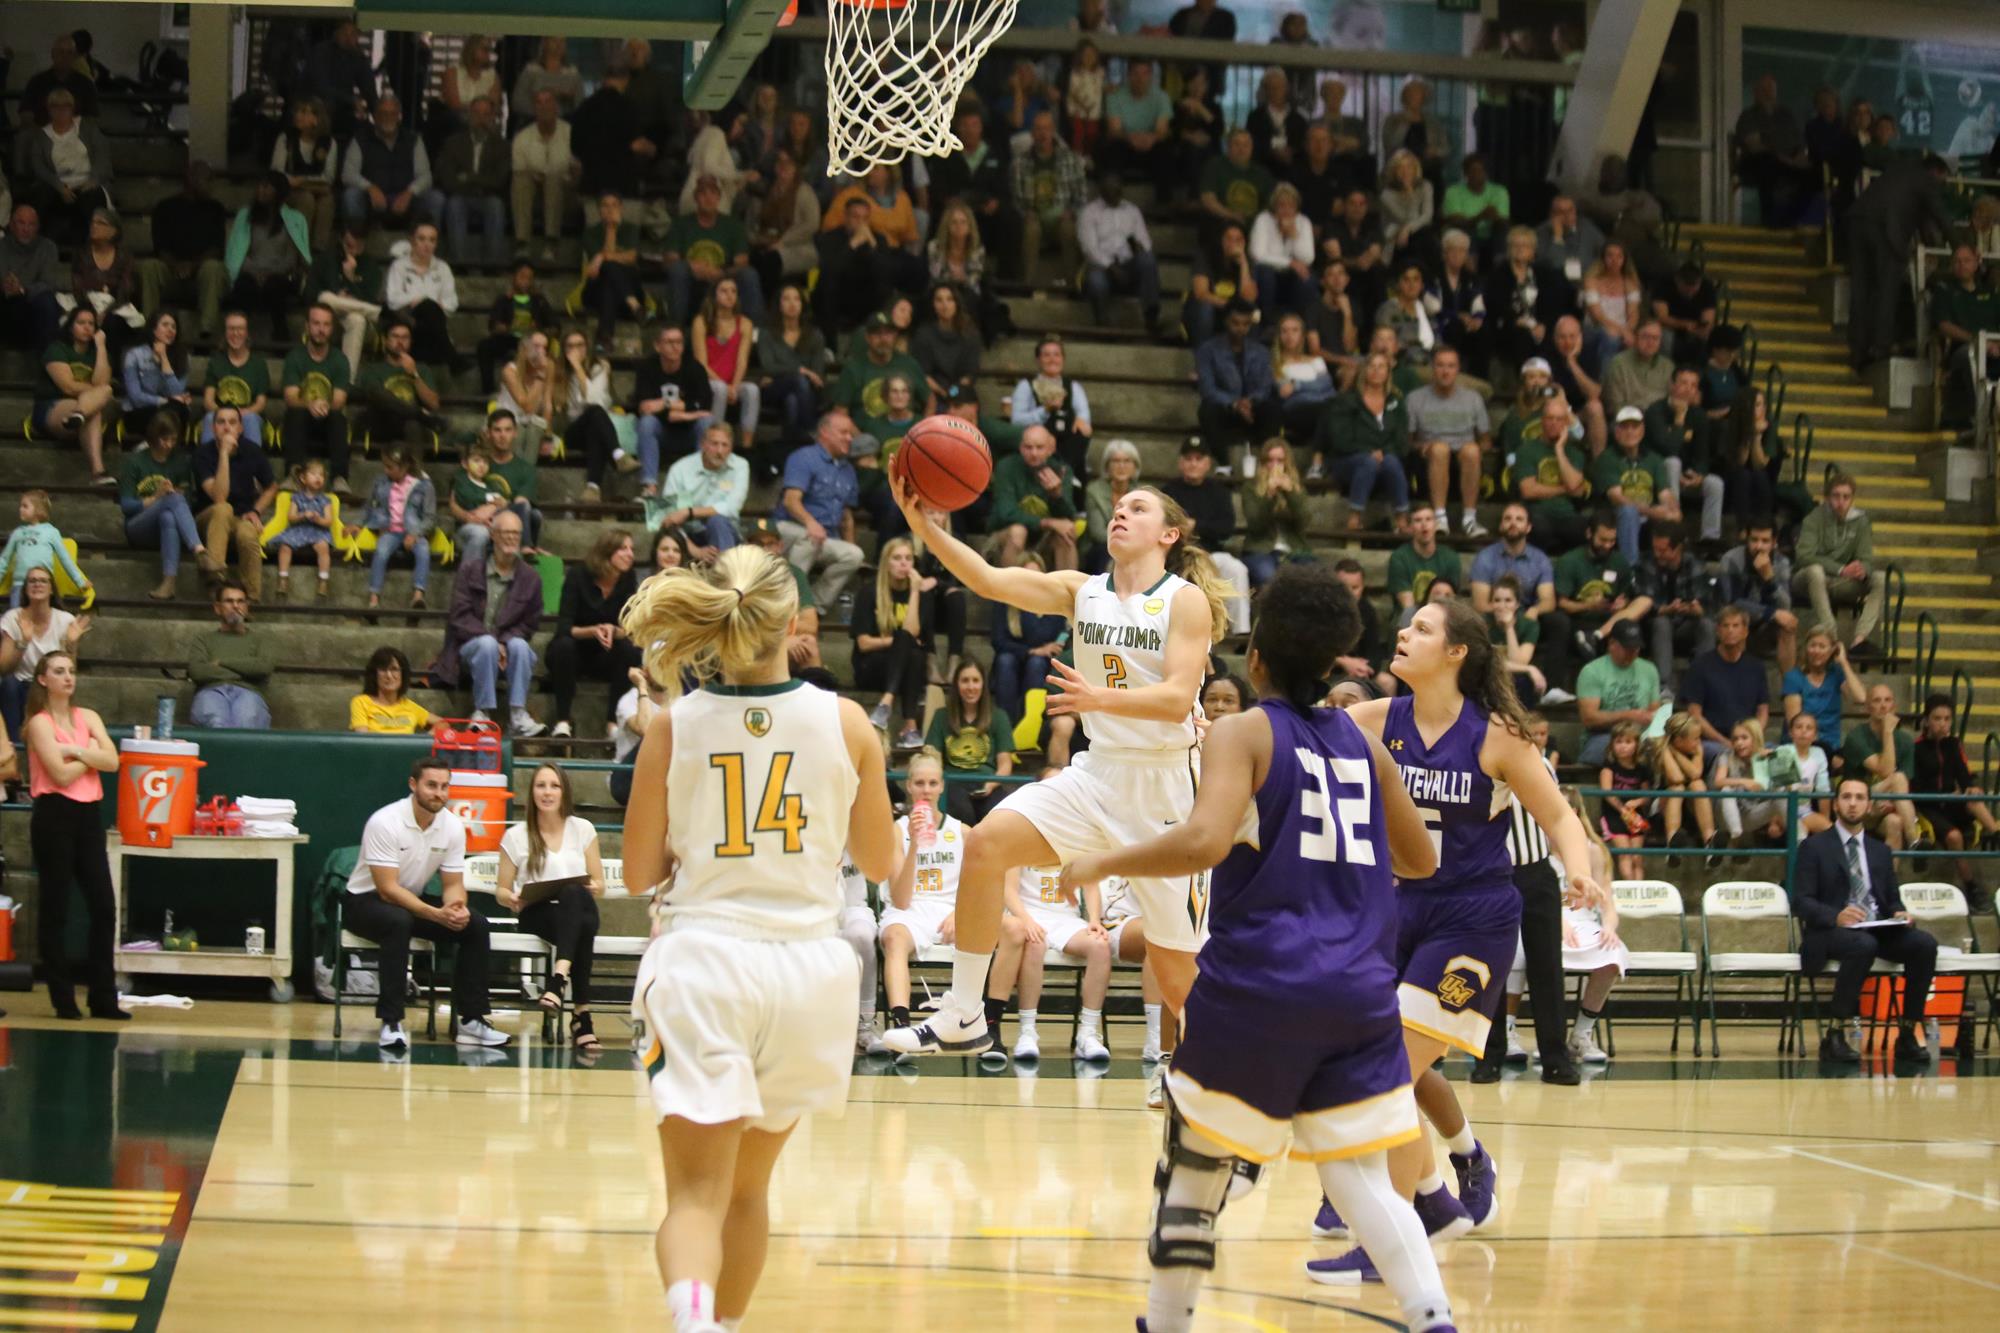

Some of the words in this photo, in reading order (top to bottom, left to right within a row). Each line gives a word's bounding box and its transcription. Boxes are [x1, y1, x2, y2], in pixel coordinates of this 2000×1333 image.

[1900, 110, 1931, 135] 42
[1078, 621, 1117, 645] POINT
[1116, 626, 1162, 651] LOMA
[1103, 653, 1128, 690] 2
[143, 770, 167, 797] G
[1396, 763, 1472, 804] NTEVALLO
[709, 751, 808, 858] 14
[1295, 747, 1377, 866] 32
[470, 862, 499, 875] POIN
[931, 851, 955, 864] LOMA
[916, 868, 943, 892] 33
[1615, 886, 1638, 900] OINT
[1717, 887, 1745, 901] POINT
[1749, 887, 1776, 901] LOMA
[1904, 888, 1928, 901] POINT
[1930, 888, 1954, 901] LOMA
